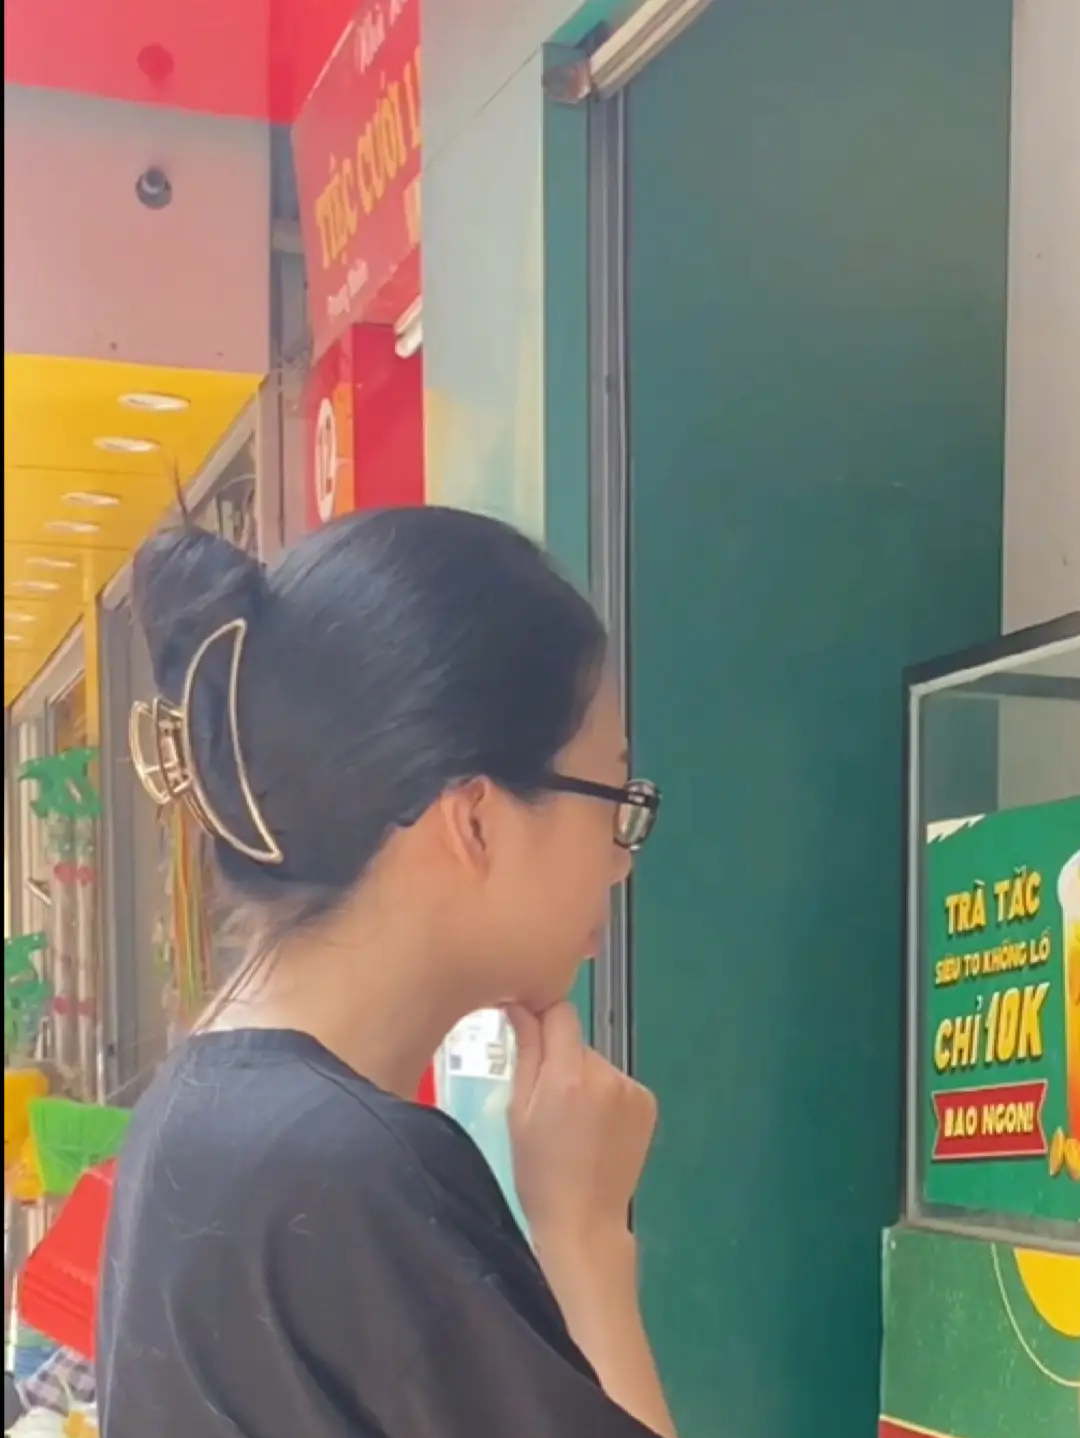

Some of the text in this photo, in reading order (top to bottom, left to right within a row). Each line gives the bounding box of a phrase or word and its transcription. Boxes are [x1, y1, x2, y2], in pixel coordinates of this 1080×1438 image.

[945, 864, 1042, 935] TRÀ TẮC
[963, 951, 981, 977] TO
[934, 994, 983, 1070] CHỈ
[985, 982, 1050, 1063] 10K
[944, 1101, 1034, 1138] BAO NGON!
